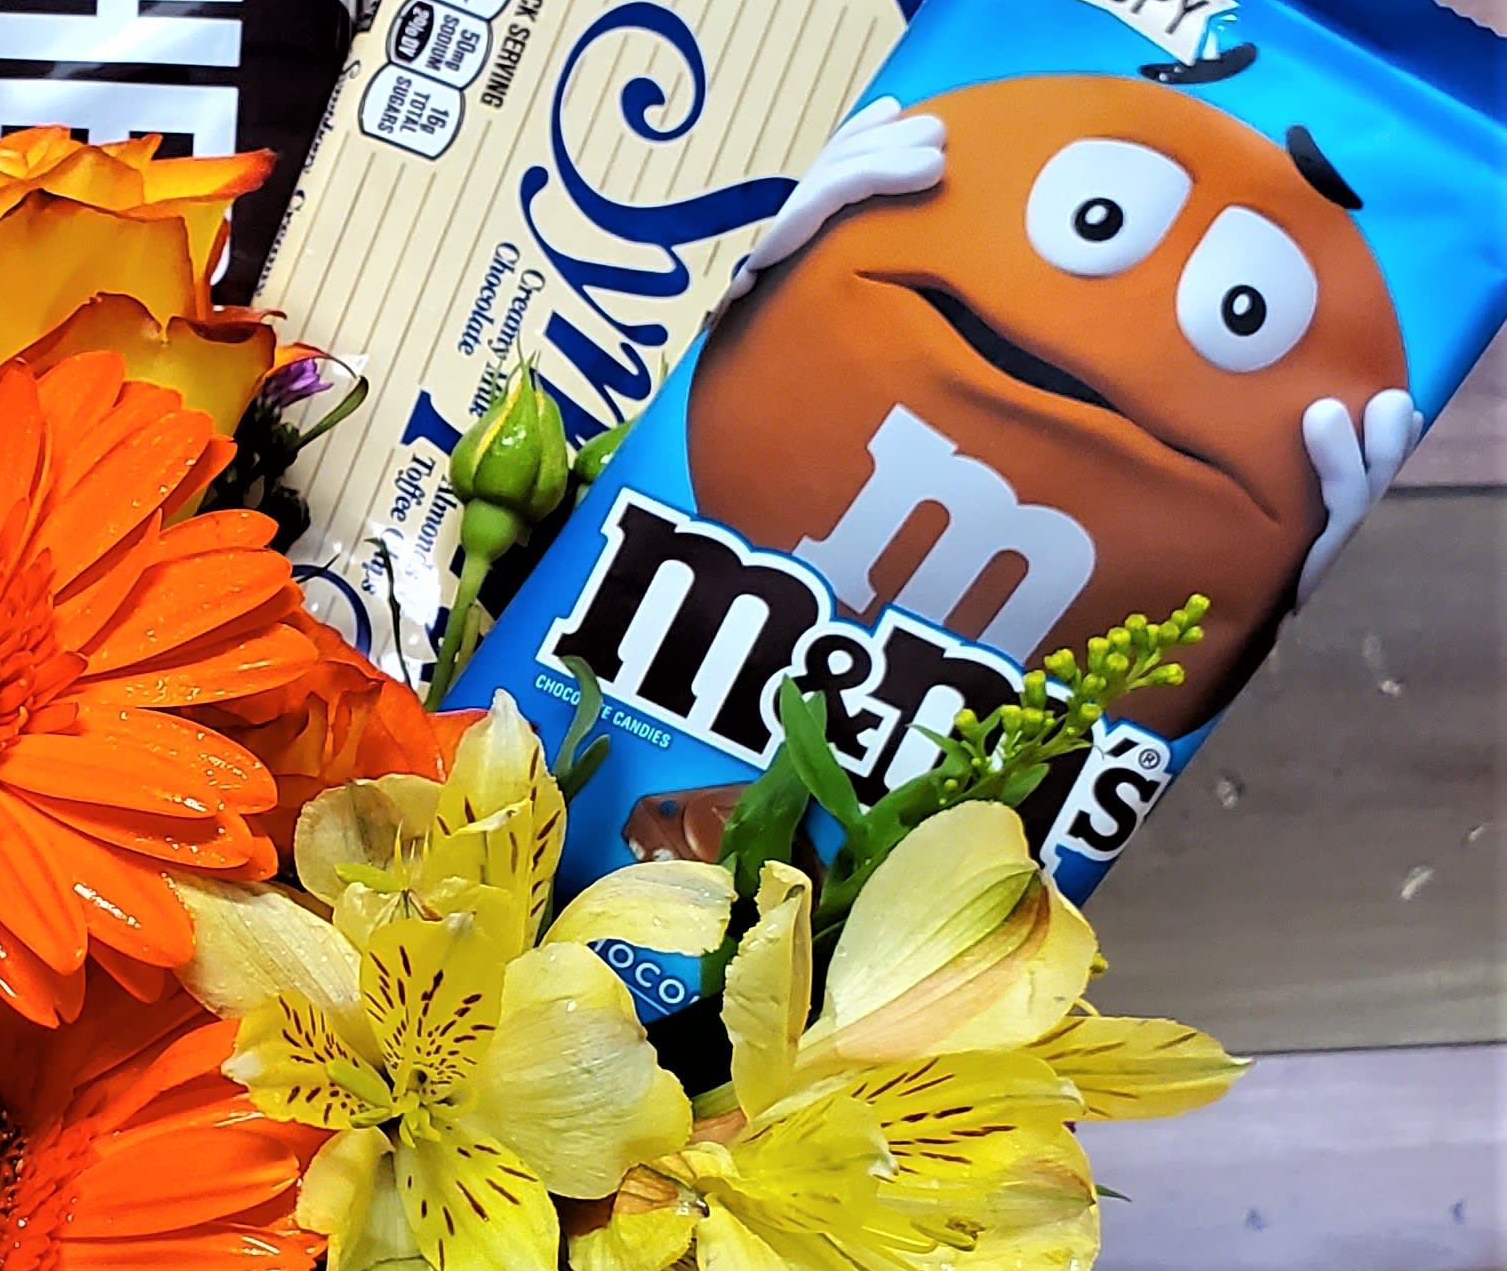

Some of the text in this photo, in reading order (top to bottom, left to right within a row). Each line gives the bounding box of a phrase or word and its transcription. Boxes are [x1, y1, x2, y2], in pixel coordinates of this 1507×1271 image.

[425, 14, 461, 72] SODIUM
[451, 28, 481, 73] 50mg
[480, 23, 531, 109] SERVING
[376, 75, 412, 134] SUGARS
[399, 91, 431, 134] TOTAL
[424, 108, 450, 135] 16g
[458, 242, 520, 356] Chocolate
[487, 269, 546, 360] Creamy
[390, 453, 436, 522] Toffee
[535, 674, 672, 749] CHOCOE CANDIES
